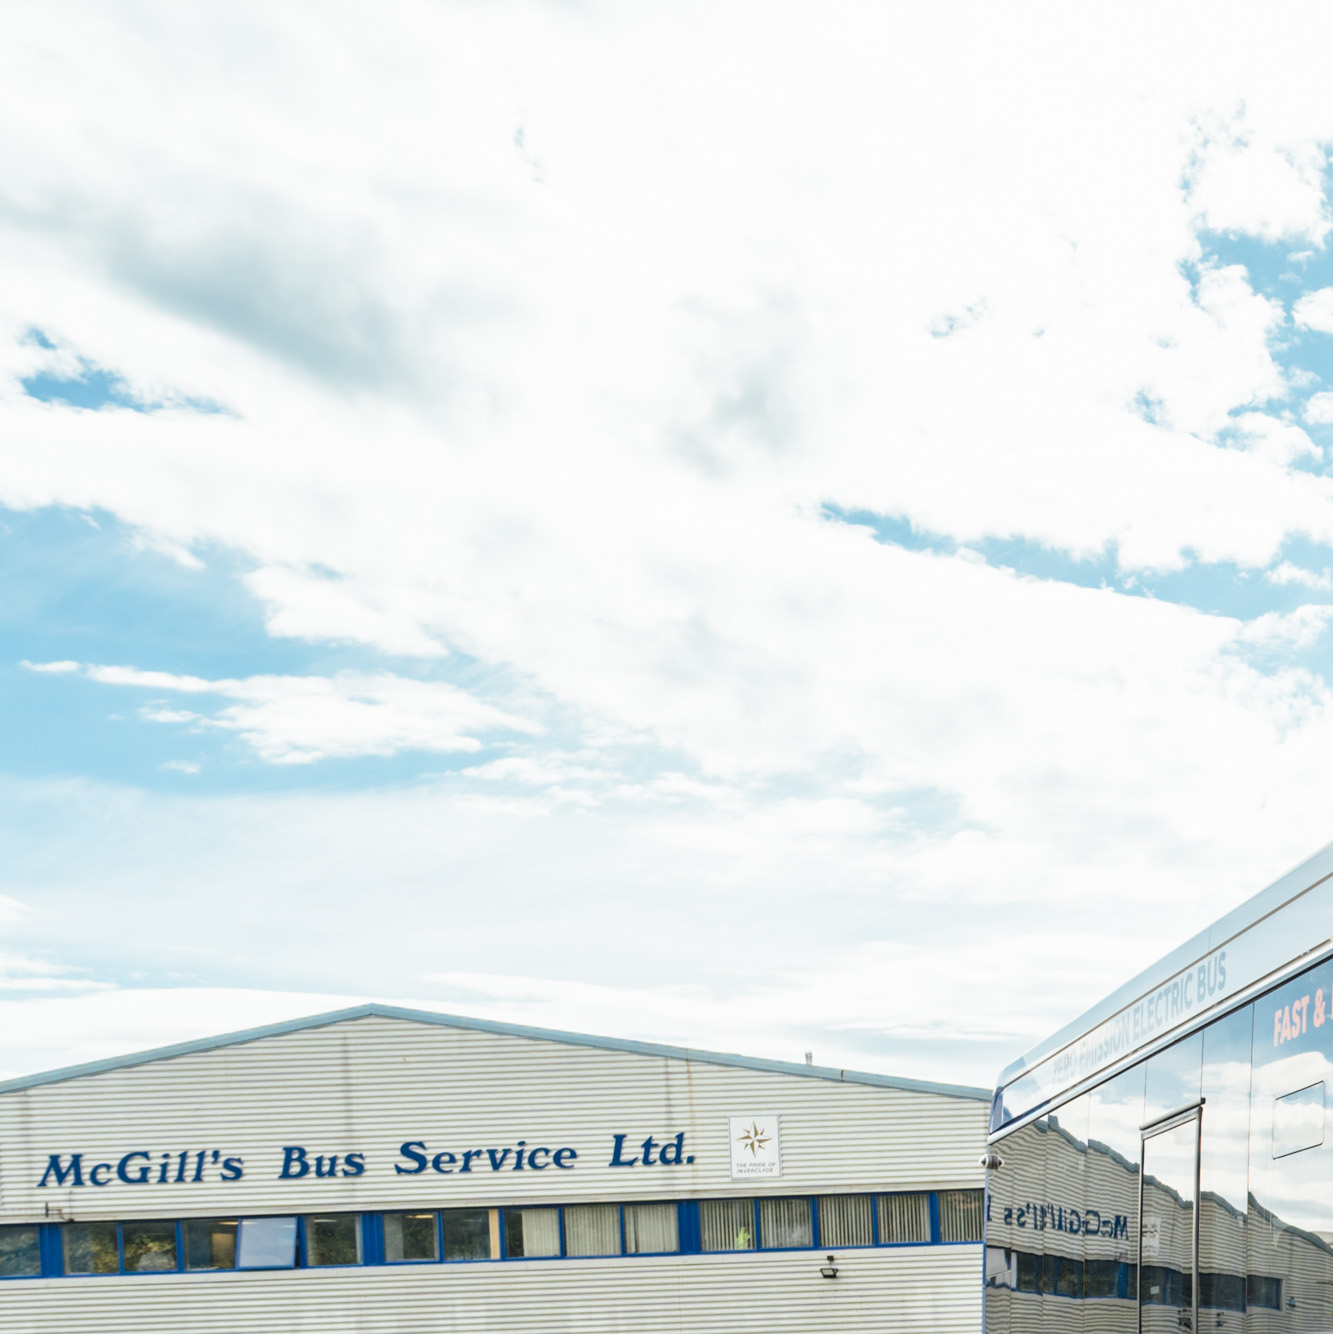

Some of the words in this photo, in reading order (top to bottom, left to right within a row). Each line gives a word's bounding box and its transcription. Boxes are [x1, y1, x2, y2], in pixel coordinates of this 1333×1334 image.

[1132, 972, 1193, 1041] ELECTRIC
[1196, 951, 1227, 1003] BUS
[1273, 995, 1310, 1047] FAST
[1313, 988, 1326, 1028] &
[37, 1150, 244, 1187] McGill's
[278, 1146, 366, 1179] Bus
[395, 1141, 578, 1174] Service
[608, 1132, 695, 1167] Ltd.
